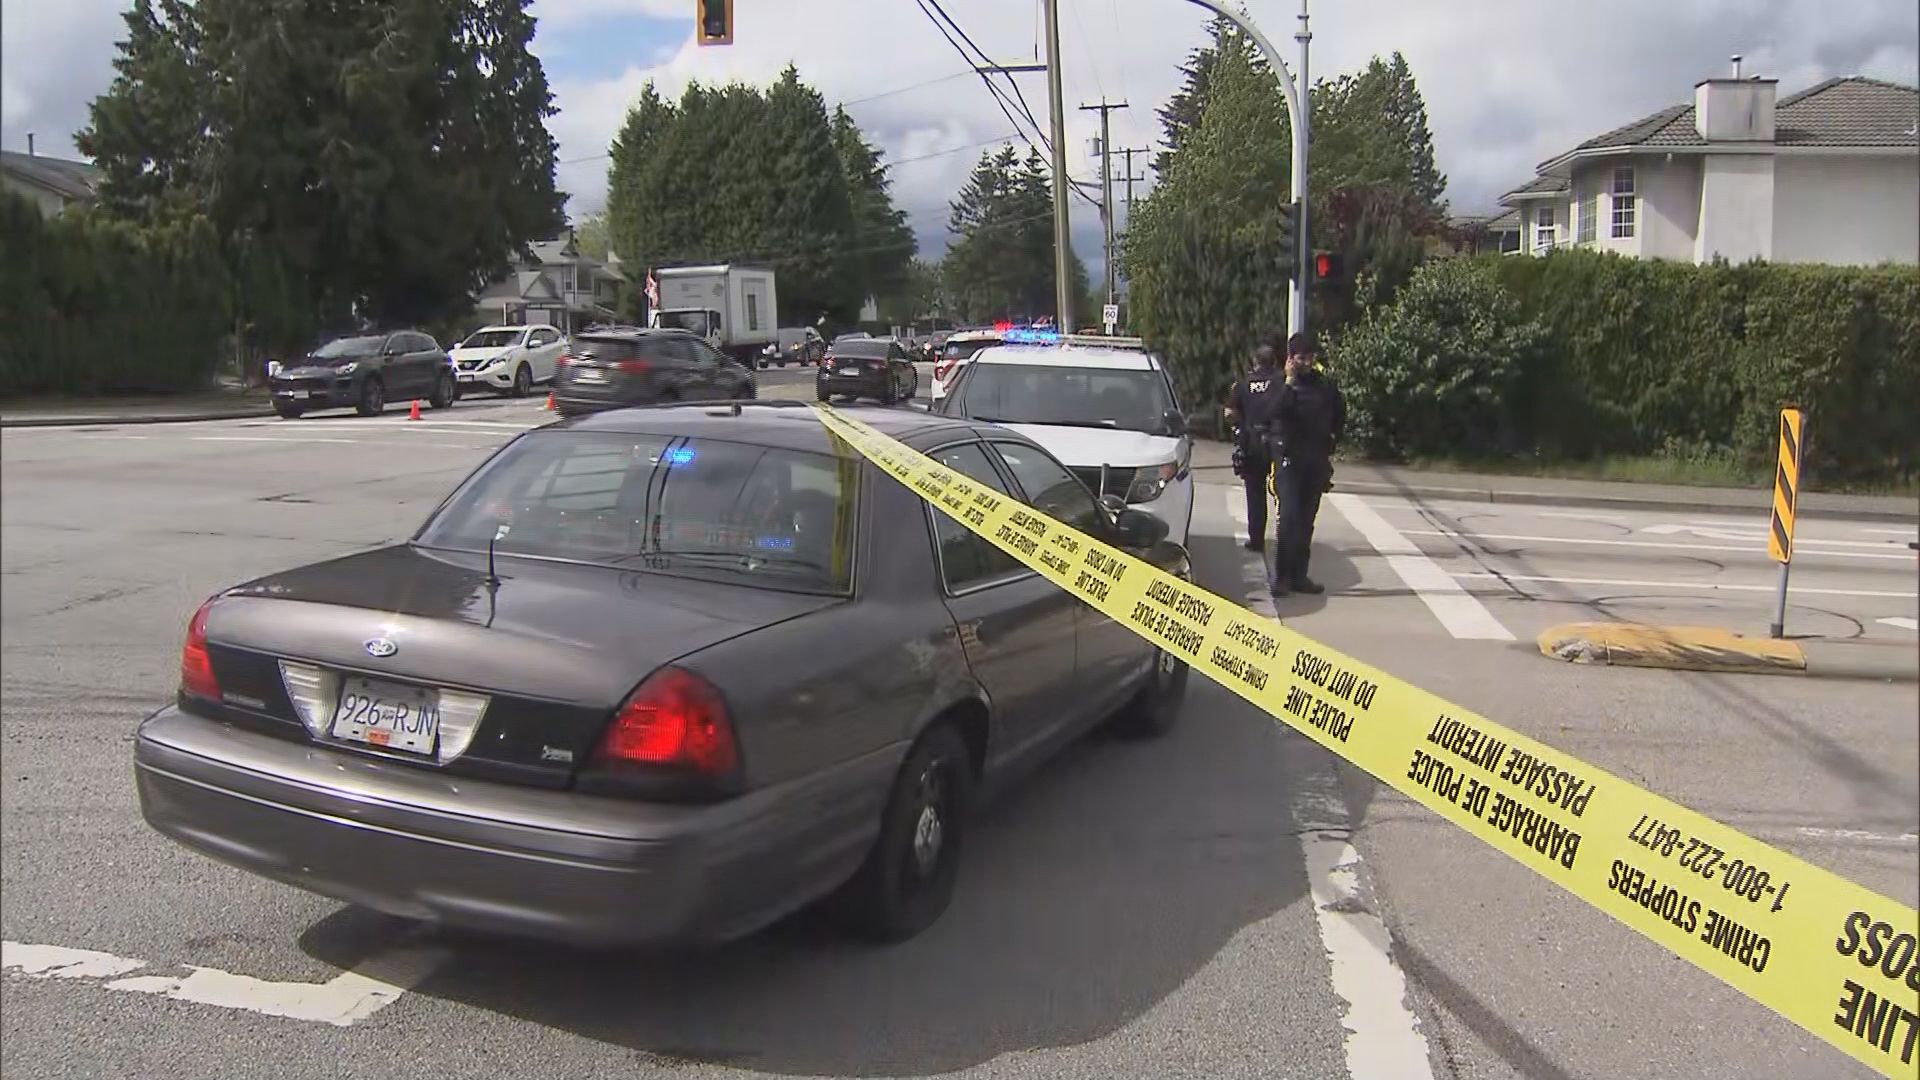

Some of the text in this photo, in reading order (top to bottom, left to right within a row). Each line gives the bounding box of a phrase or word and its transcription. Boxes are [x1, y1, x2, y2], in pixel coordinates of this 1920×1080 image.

[1105, 311, 1116, 319] 60
[1130, 601, 1204, 657] BARRAGE DE POLICE
[1145, 578, 1215, 626] PASSAGE INTERDIT
[1210, 646, 1269, 691] CRIME STOPPERS
[1291, 650, 1378, 711] DO NOT CROSS
[342, 694, 435, 736] 926 RJN
[1283, 686, 1354, 743] POLICE LINE
[1426, 714, 1596, 818] PASSAGE INTERDIT
[1407, 750, 1582, 870] BARRAGE DE POLICE
[1628, 815, 1791, 913] 1-800-222-8477
[1608, 859, 1772, 973] CRIME STOPPERS
[1834, 978, 1919, 1065] LINE
